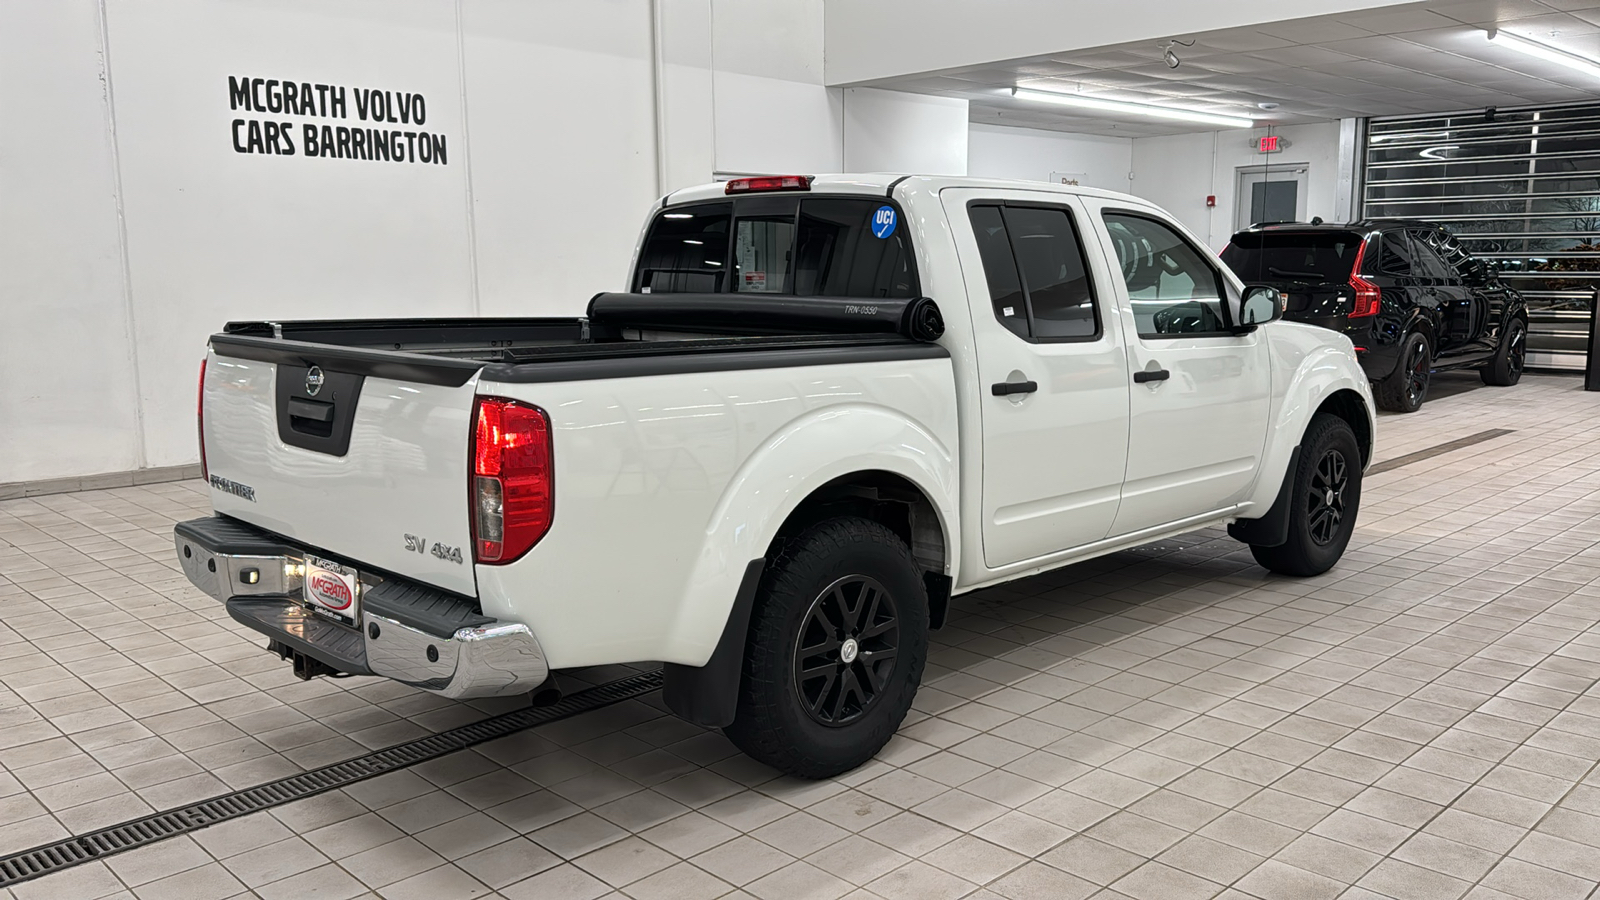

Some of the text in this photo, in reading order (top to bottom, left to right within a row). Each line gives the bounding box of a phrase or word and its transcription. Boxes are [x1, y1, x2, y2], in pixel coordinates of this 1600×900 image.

[228, 75, 426, 126] MCGRATH VOLVO
[232, 118, 448, 166] CARS BARRINGTON
[1260, 136, 1278, 152] EXIT
[876, 210, 895, 226] UCI
[844, 305, 878, 315] TRN-0550
[210, 474, 257, 503] FRONTIER
[403, 533, 426, 554] SV
